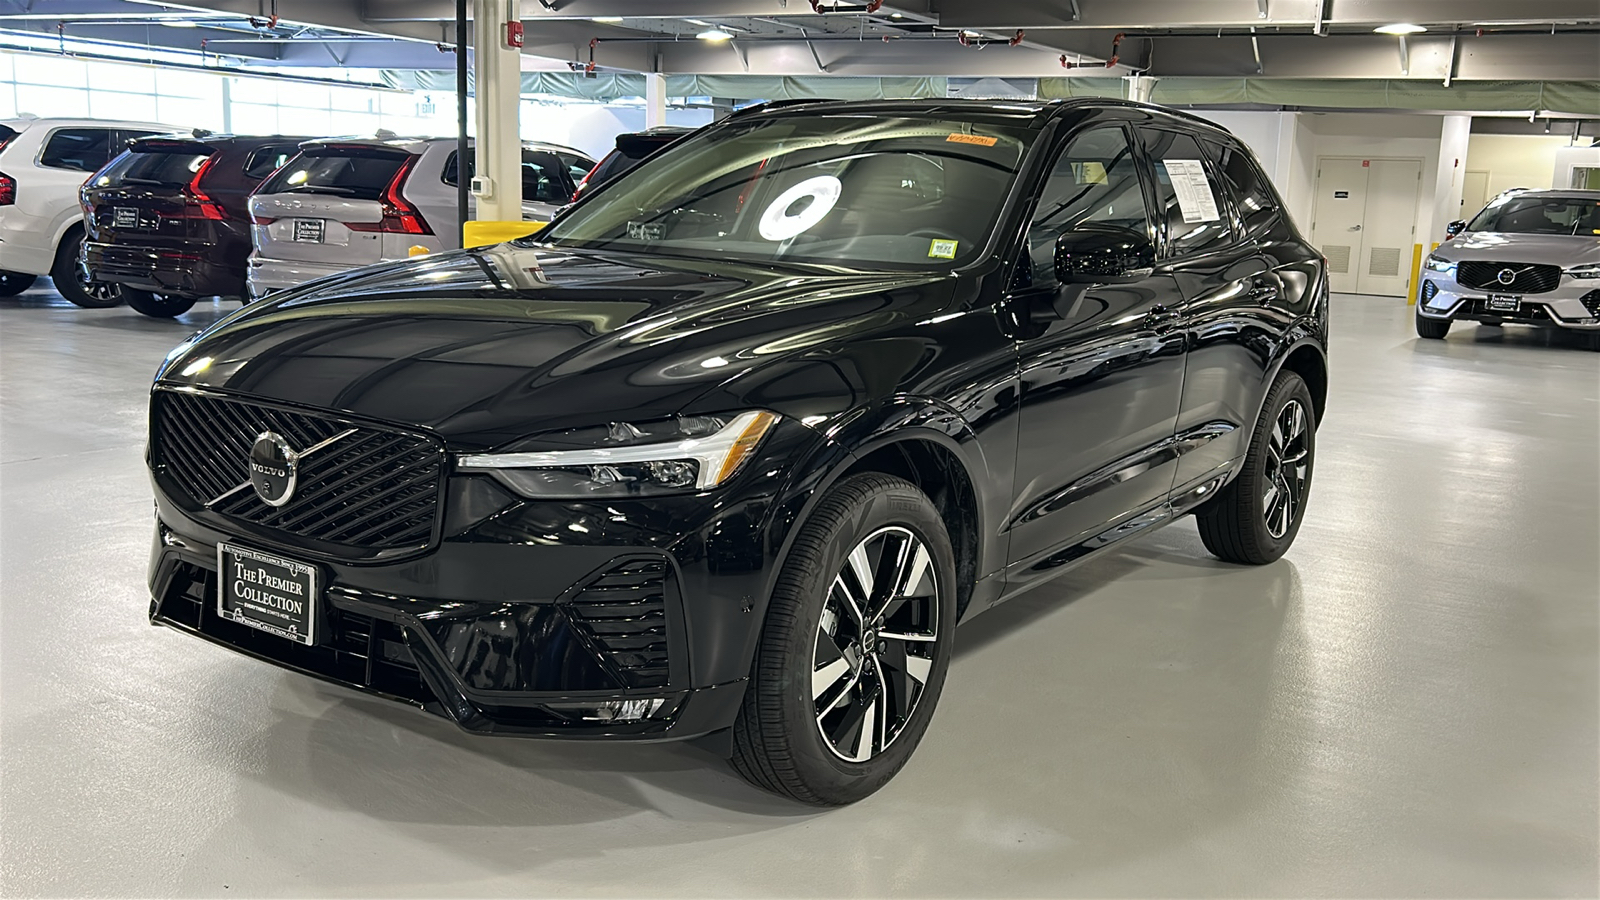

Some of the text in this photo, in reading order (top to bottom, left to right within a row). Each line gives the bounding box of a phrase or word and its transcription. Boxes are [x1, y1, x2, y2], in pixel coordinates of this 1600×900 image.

[251, 462, 286, 478] VOLVO
[224, 544, 309, 574] AUTOMOTIVE EXCELLENCE SINCE 1995
[234, 562, 303, 596] THE PREMIER
[234, 580, 303, 615] COLLECTION
